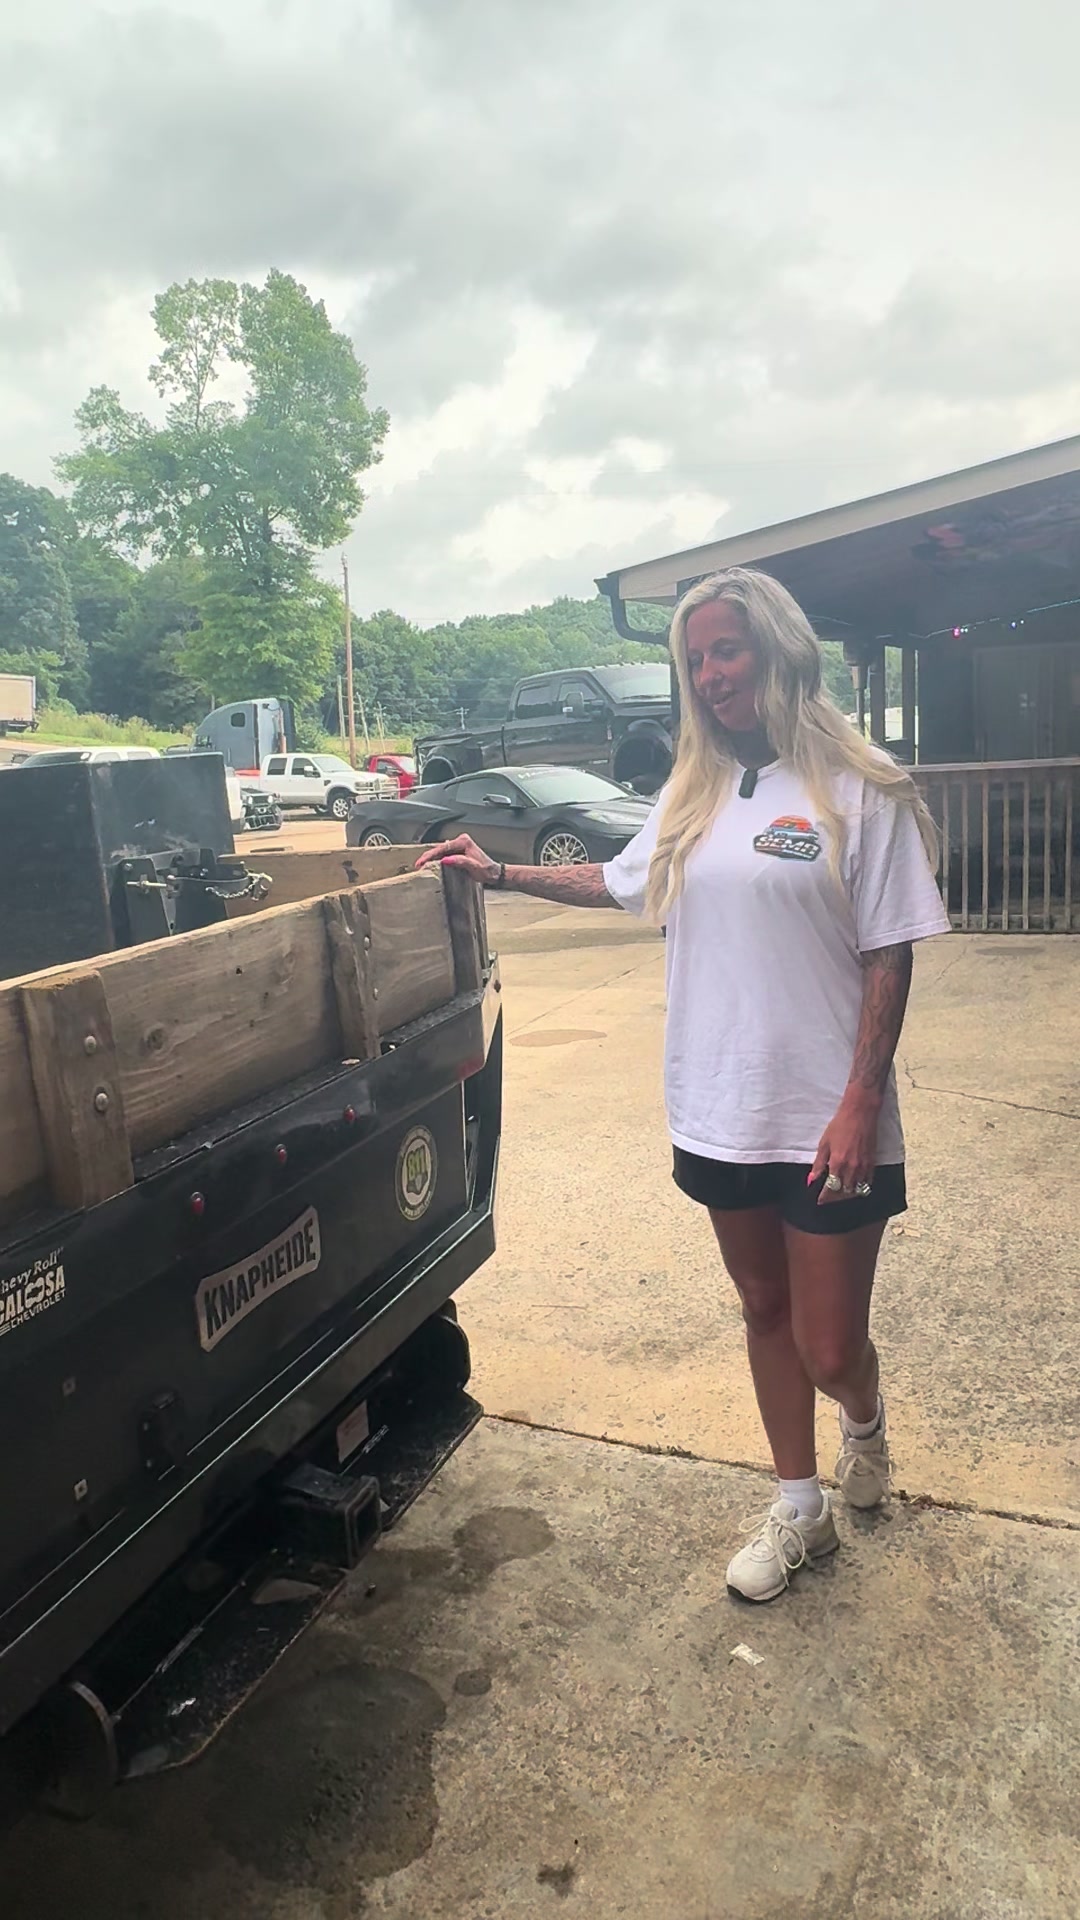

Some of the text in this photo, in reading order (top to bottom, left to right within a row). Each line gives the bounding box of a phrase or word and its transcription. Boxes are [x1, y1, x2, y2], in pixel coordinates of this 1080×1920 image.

[0, 1269, 32, 1293] hevy
[204, 1217, 316, 1339] KNAPHEIDE
[11, 1288, 66, 1329] CHEVROLET
